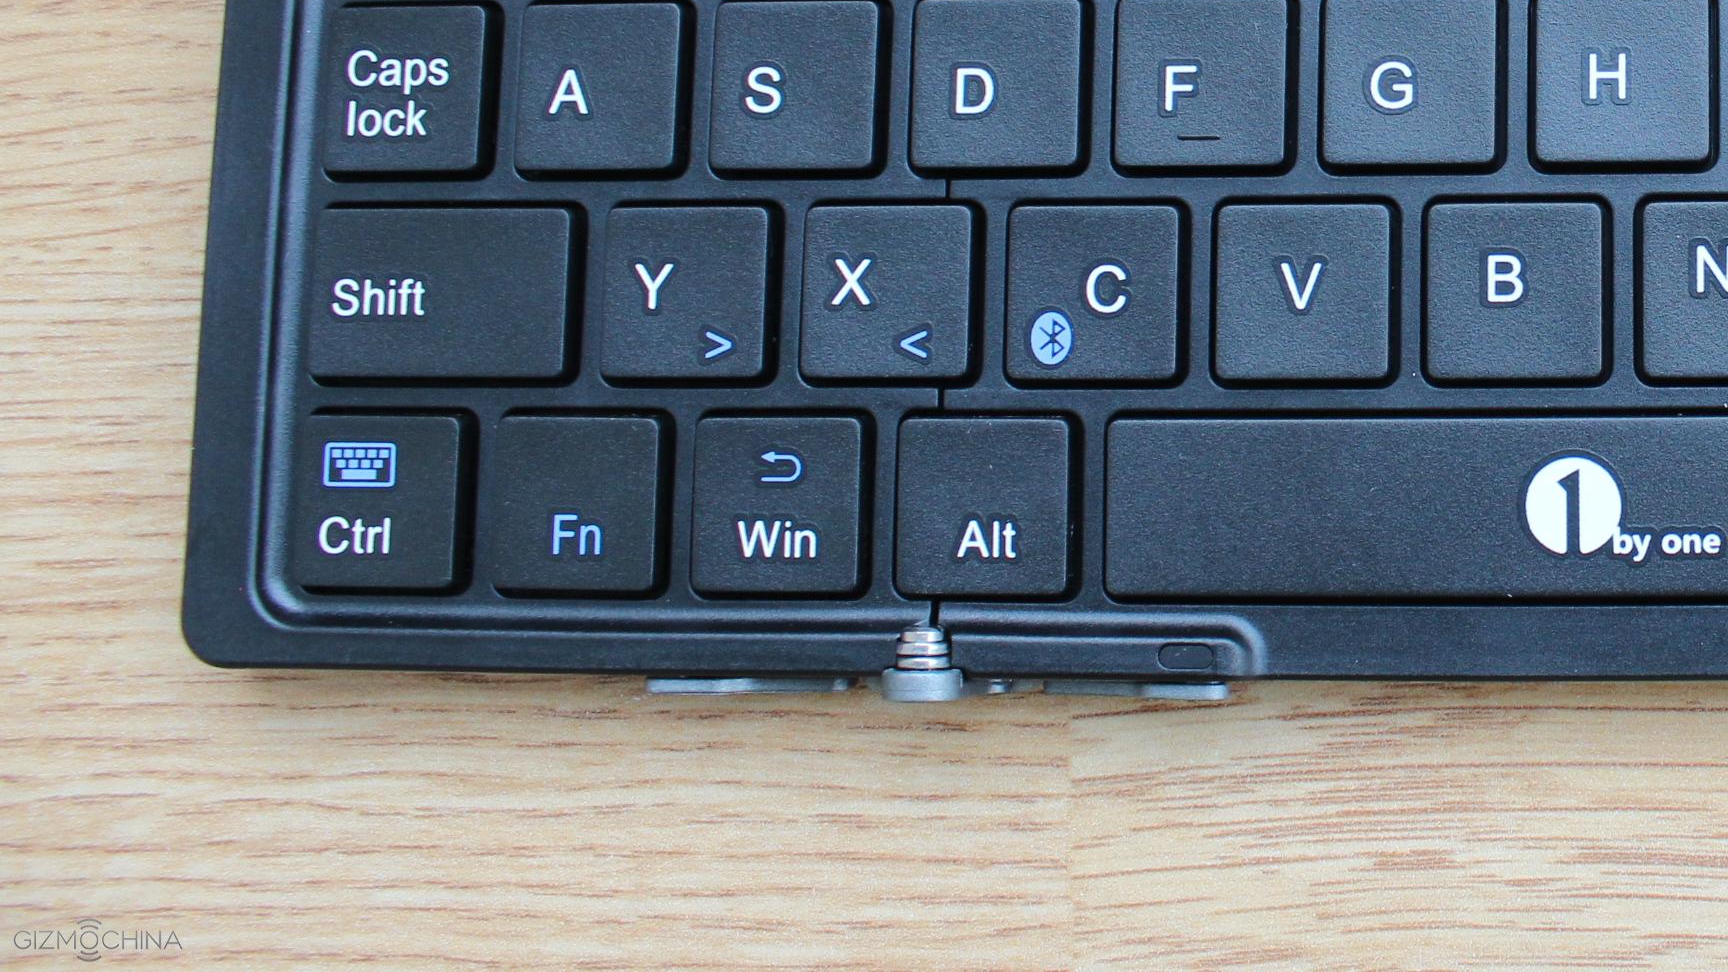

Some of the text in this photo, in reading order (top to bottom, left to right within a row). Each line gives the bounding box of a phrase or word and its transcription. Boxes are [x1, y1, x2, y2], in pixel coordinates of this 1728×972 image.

[347, 49, 449, 95] Caps
[548, 69, 589, 115] A
[745, 66, 782, 114] S
[955, 67, 994, 114] D
[1164, 65, 1197, 112] F
[1370, 61, 1414, 110] G
[1589, 53, 1627, 100] H
[346, 100, 427, 137] lock
[331, 278, 426, 317] Shift
[634, 263, 674, 310] Y
[831, 258, 871, 306] X
[1086, 264, 1127, 314] C
[1280, 262, 1322, 310] V
[1487, 254, 1524, 303] B
[318, 516, 391, 555] Ctrl
[552, 514, 601, 556] Fn
[737, 520, 817, 558] Win
[956, 520, 1017, 559] Alt
[1612, 528, 1652, 561] by
[1661, 533, 1722, 554] one
